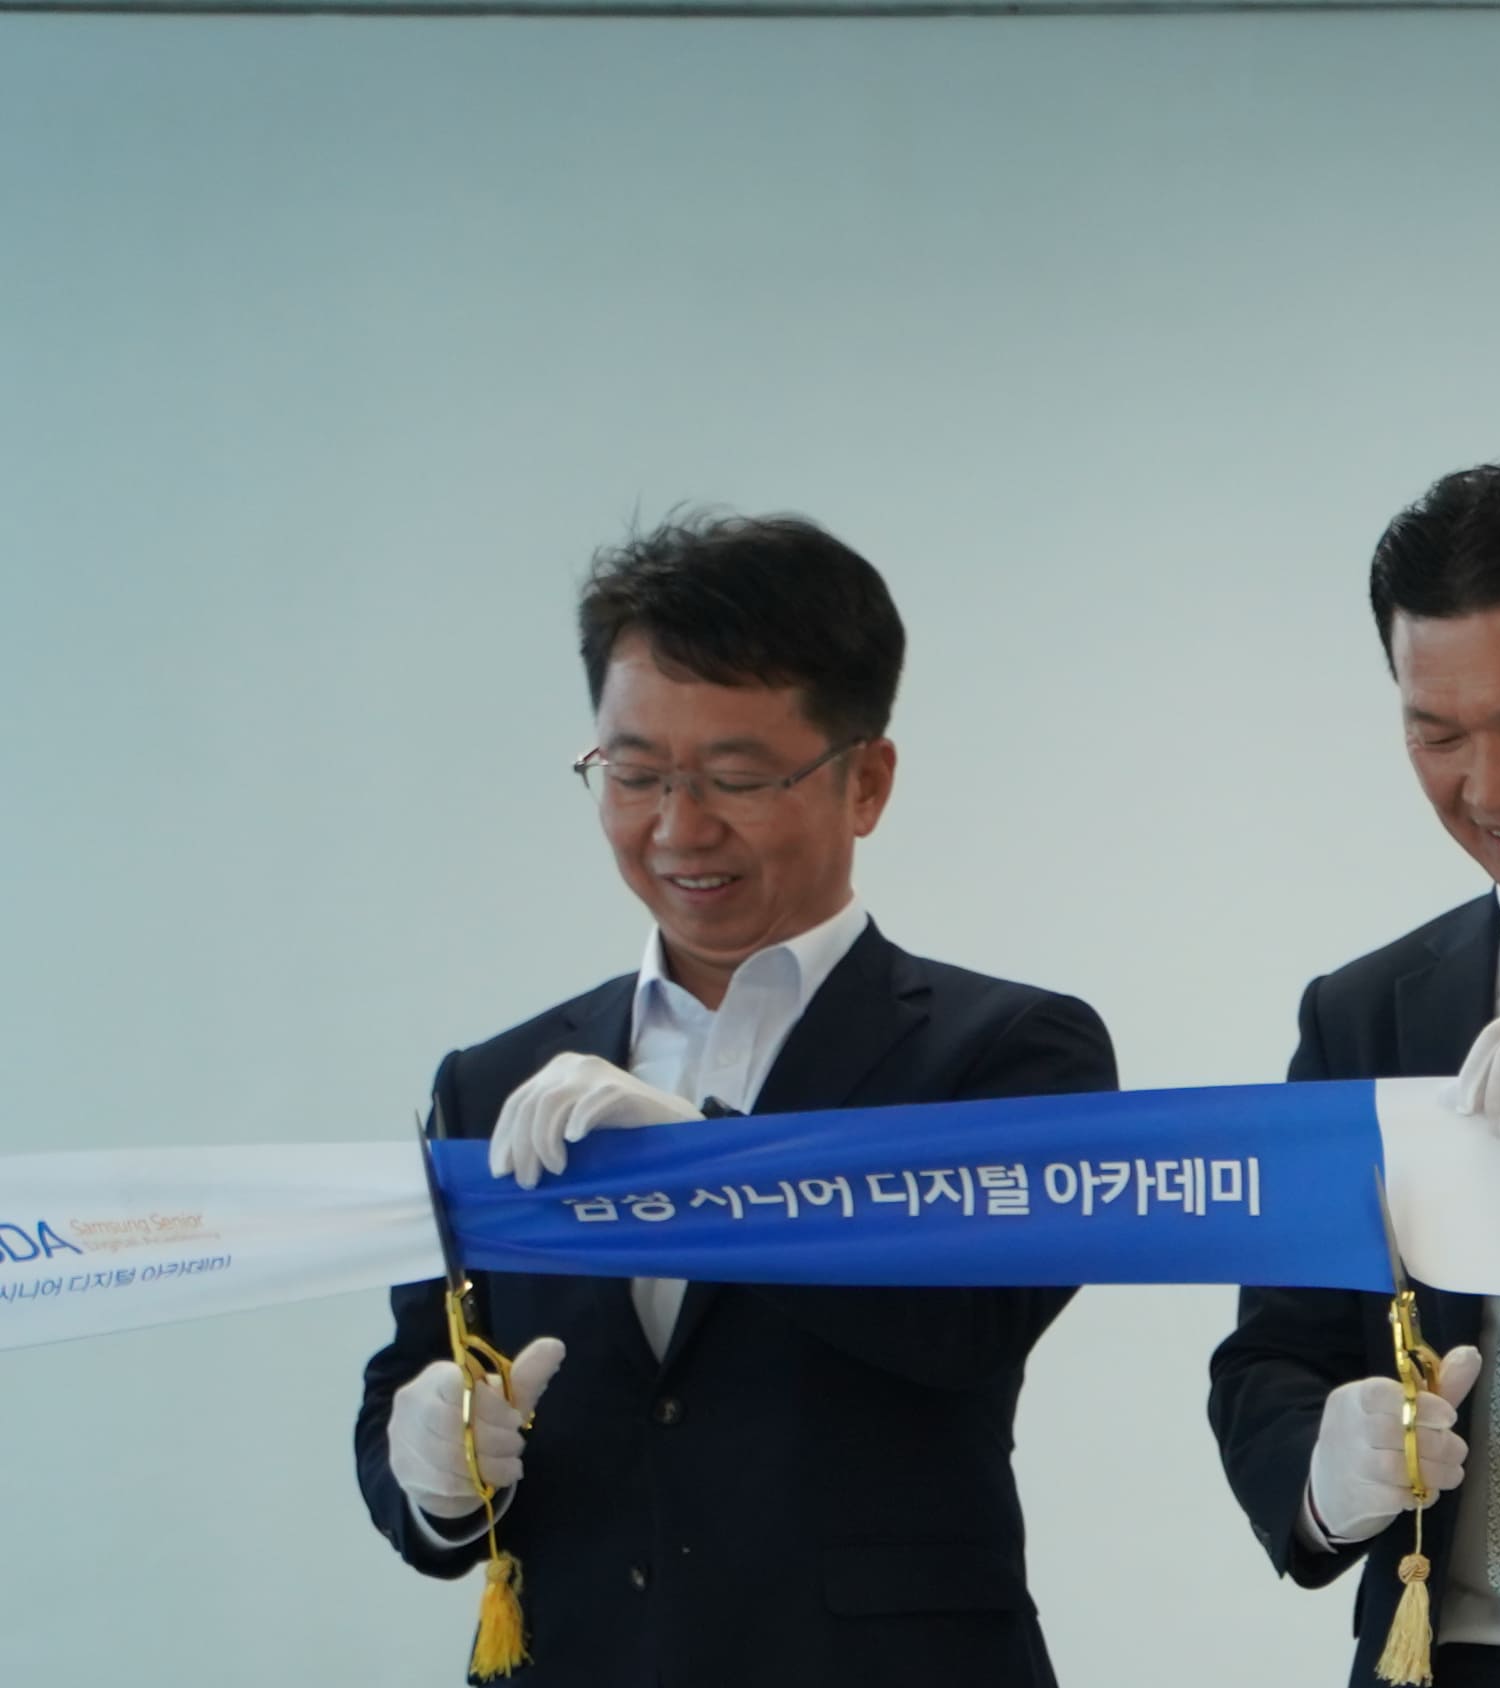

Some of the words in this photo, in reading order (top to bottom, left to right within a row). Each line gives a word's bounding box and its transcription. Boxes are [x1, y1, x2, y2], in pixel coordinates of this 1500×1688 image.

[690, 1176, 854, 1218] 시니어
[866, 1166, 1030, 1217] 디지털
[1044, 1157, 1262, 1216] 아카데미
[0, 1221, 82, 1264] DA
[68, 1267, 137, 1292] 디지털
[140, 1254, 232, 1281] 아카데미
